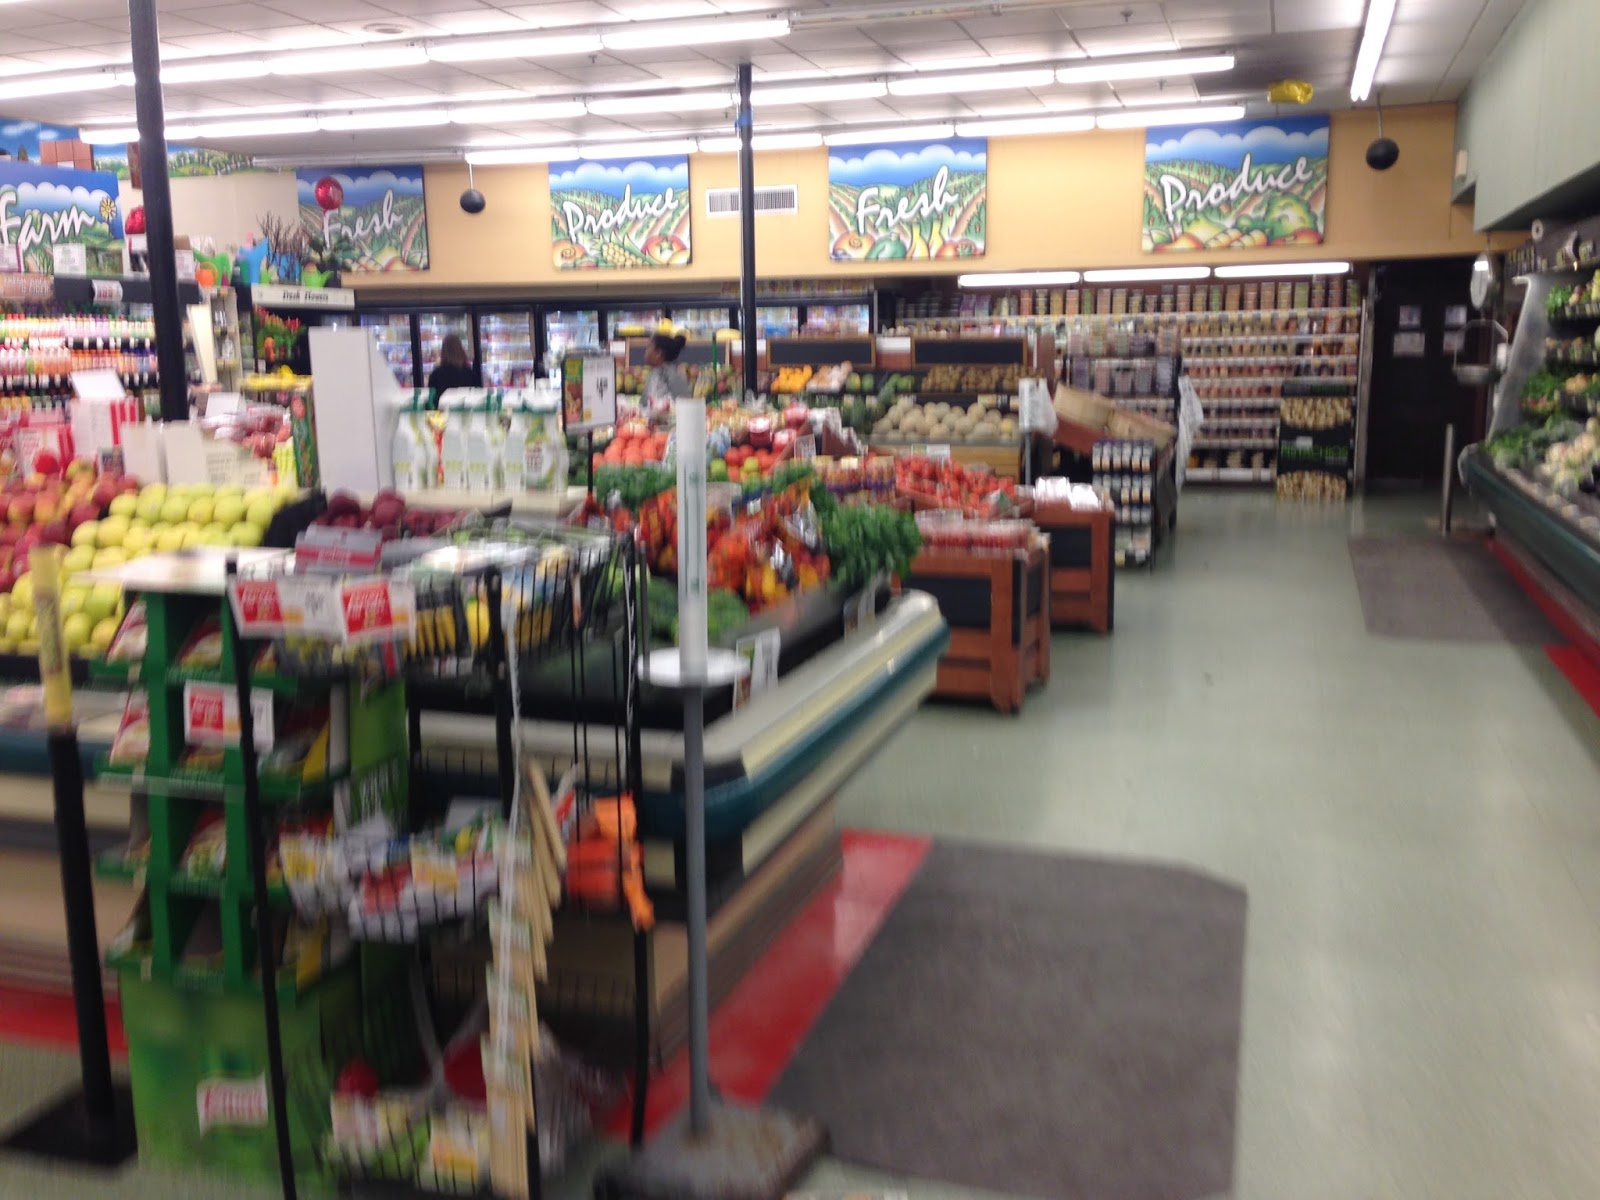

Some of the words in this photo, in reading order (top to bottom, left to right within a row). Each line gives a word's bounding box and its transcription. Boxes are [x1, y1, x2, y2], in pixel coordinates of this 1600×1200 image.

[562, 184, 679, 240] Produce
[856, 165, 959, 235] Fresh
[1159, 153, 1313, 222] Produce
[0, 191, 95, 252] Farm
[323, 189, 403, 249] Fresh
